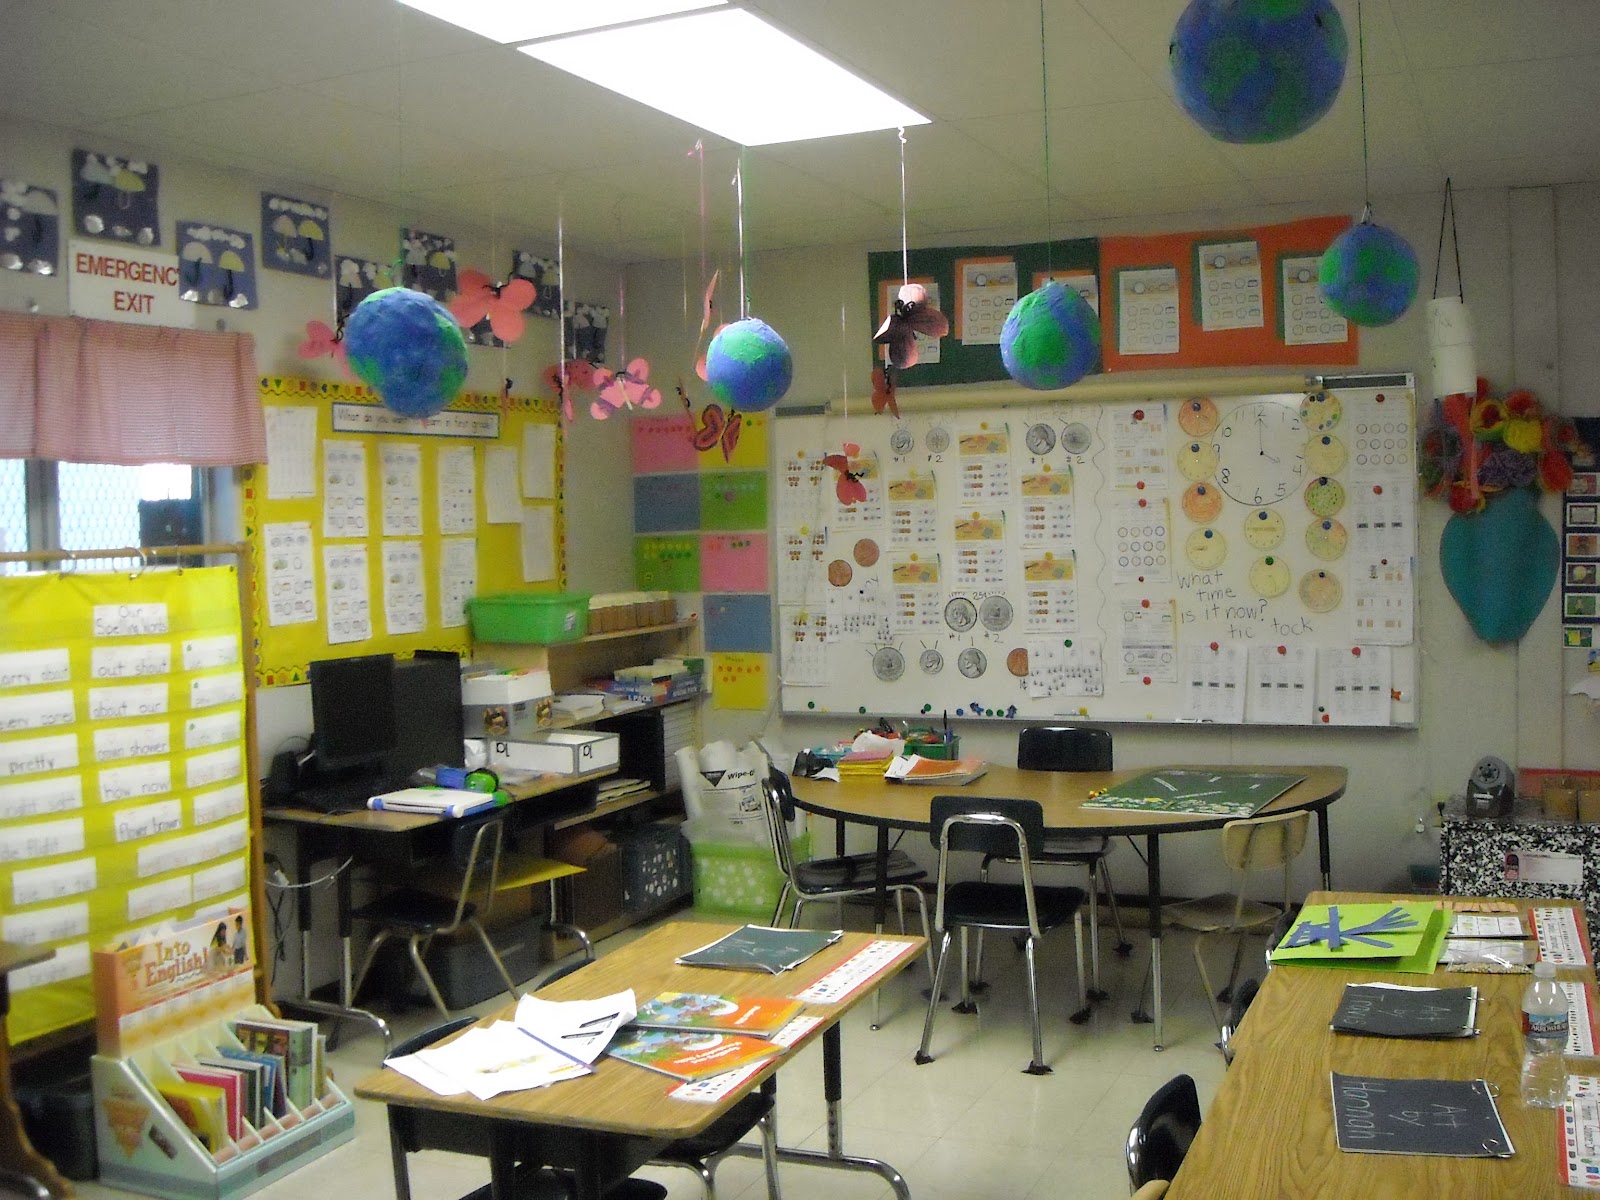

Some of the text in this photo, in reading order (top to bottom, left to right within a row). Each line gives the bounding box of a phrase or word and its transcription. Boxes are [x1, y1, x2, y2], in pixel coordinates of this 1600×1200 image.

[76, 253, 180, 287] EMERGENC
[113, 290, 155, 315] EXIT
[1253, 404, 1267, 418] 12
[1221, 426, 1233, 439] 10
[1221, 468, 1231, 485] 8
[1253, 487, 1263, 505] 6
[1274, 482, 1287, 498] 5
[1176, 569, 1224, 590] What
[1195, 586, 1237, 602] time
[117, 604, 143, 619] Our
[1180, 598, 1269, 625] is it now?
[95, 617, 140, 636] Spelling
[1228, 616, 1315, 640] tic tock
[97, 660, 124, 678] out
[135, 657, 168, 676] shout
[92, 701, 128, 720] about
[138, 701, 161, 715] our
[129, 739, 167, 758] shower
[8, 754, 56, 777] pretty
[103, 780, 169, 799] how now
[152, 815, 181, 835] brown
[155, 941, 192, 965] Into
[144, 946, 208, 988] English!
[1341, 1081, 1396, 1139] Hannah
[1388, 1110, 1434, 1127] by
[1430, 1103, 1471, 1129] Art
